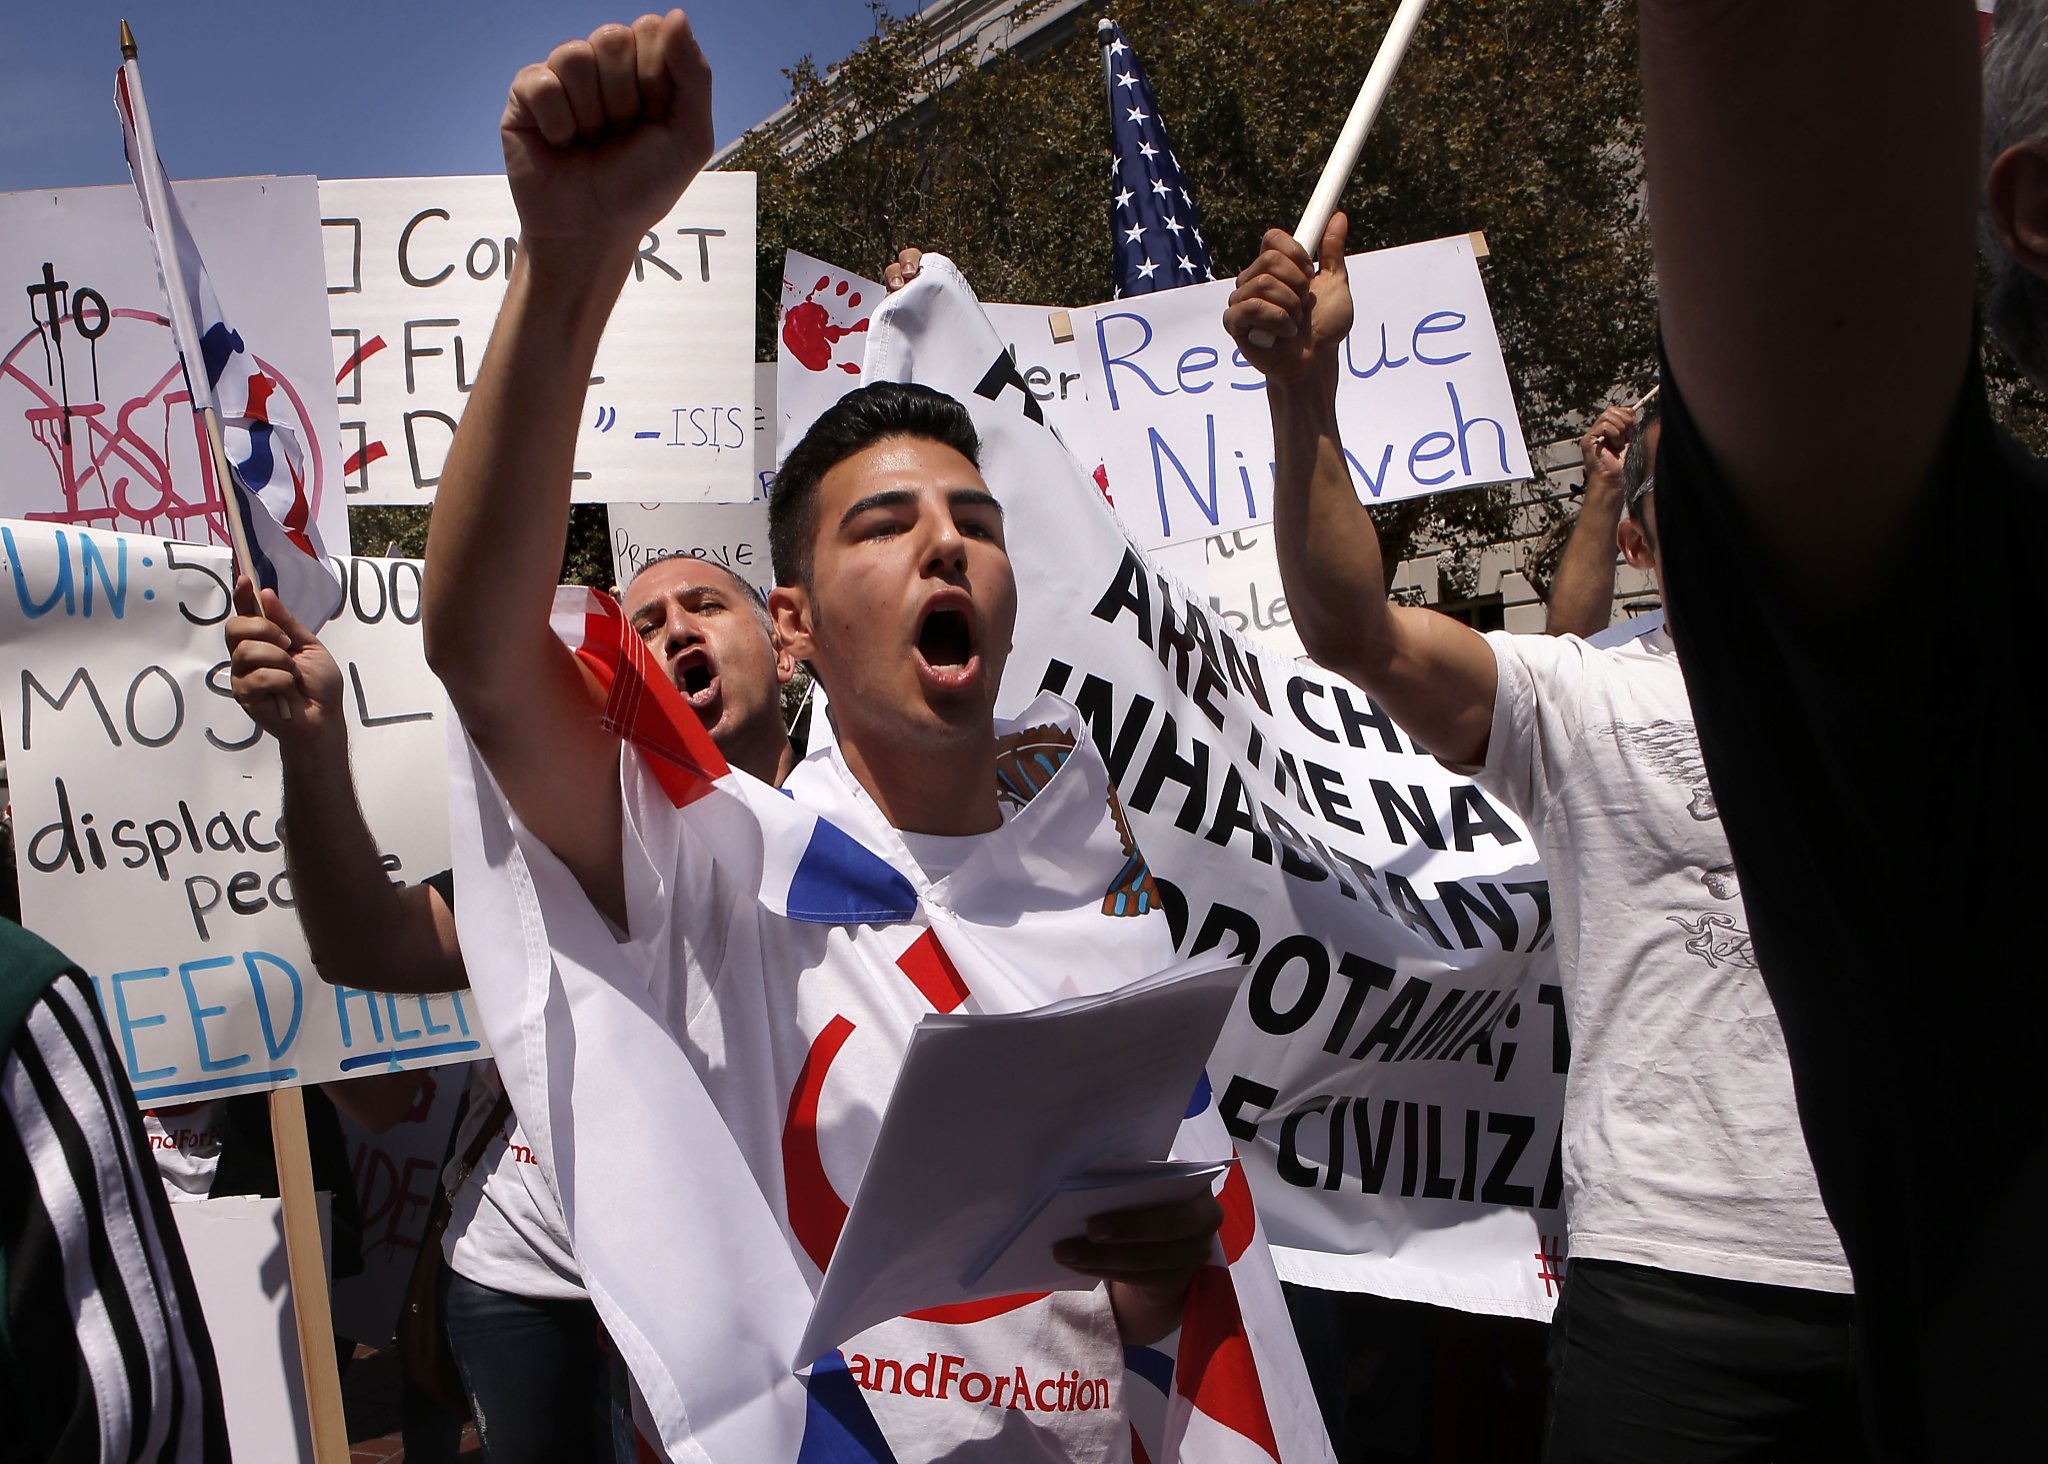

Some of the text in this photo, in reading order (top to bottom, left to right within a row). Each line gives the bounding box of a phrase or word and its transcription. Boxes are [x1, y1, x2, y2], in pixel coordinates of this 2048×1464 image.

[26, 262, 110, 343] to
[1095, 311, 1471, 411] Resue
[1147, 381, 1512, 537] Niveh
[22, 662, 434, 752] MOSL
[27, 776, 286, 882] displac
[90, 950, 304, 1083] EED
[1275, 1094, 1567, 1211] CIVILIZ
[836, 1348, 1110, 1413] andForAction
